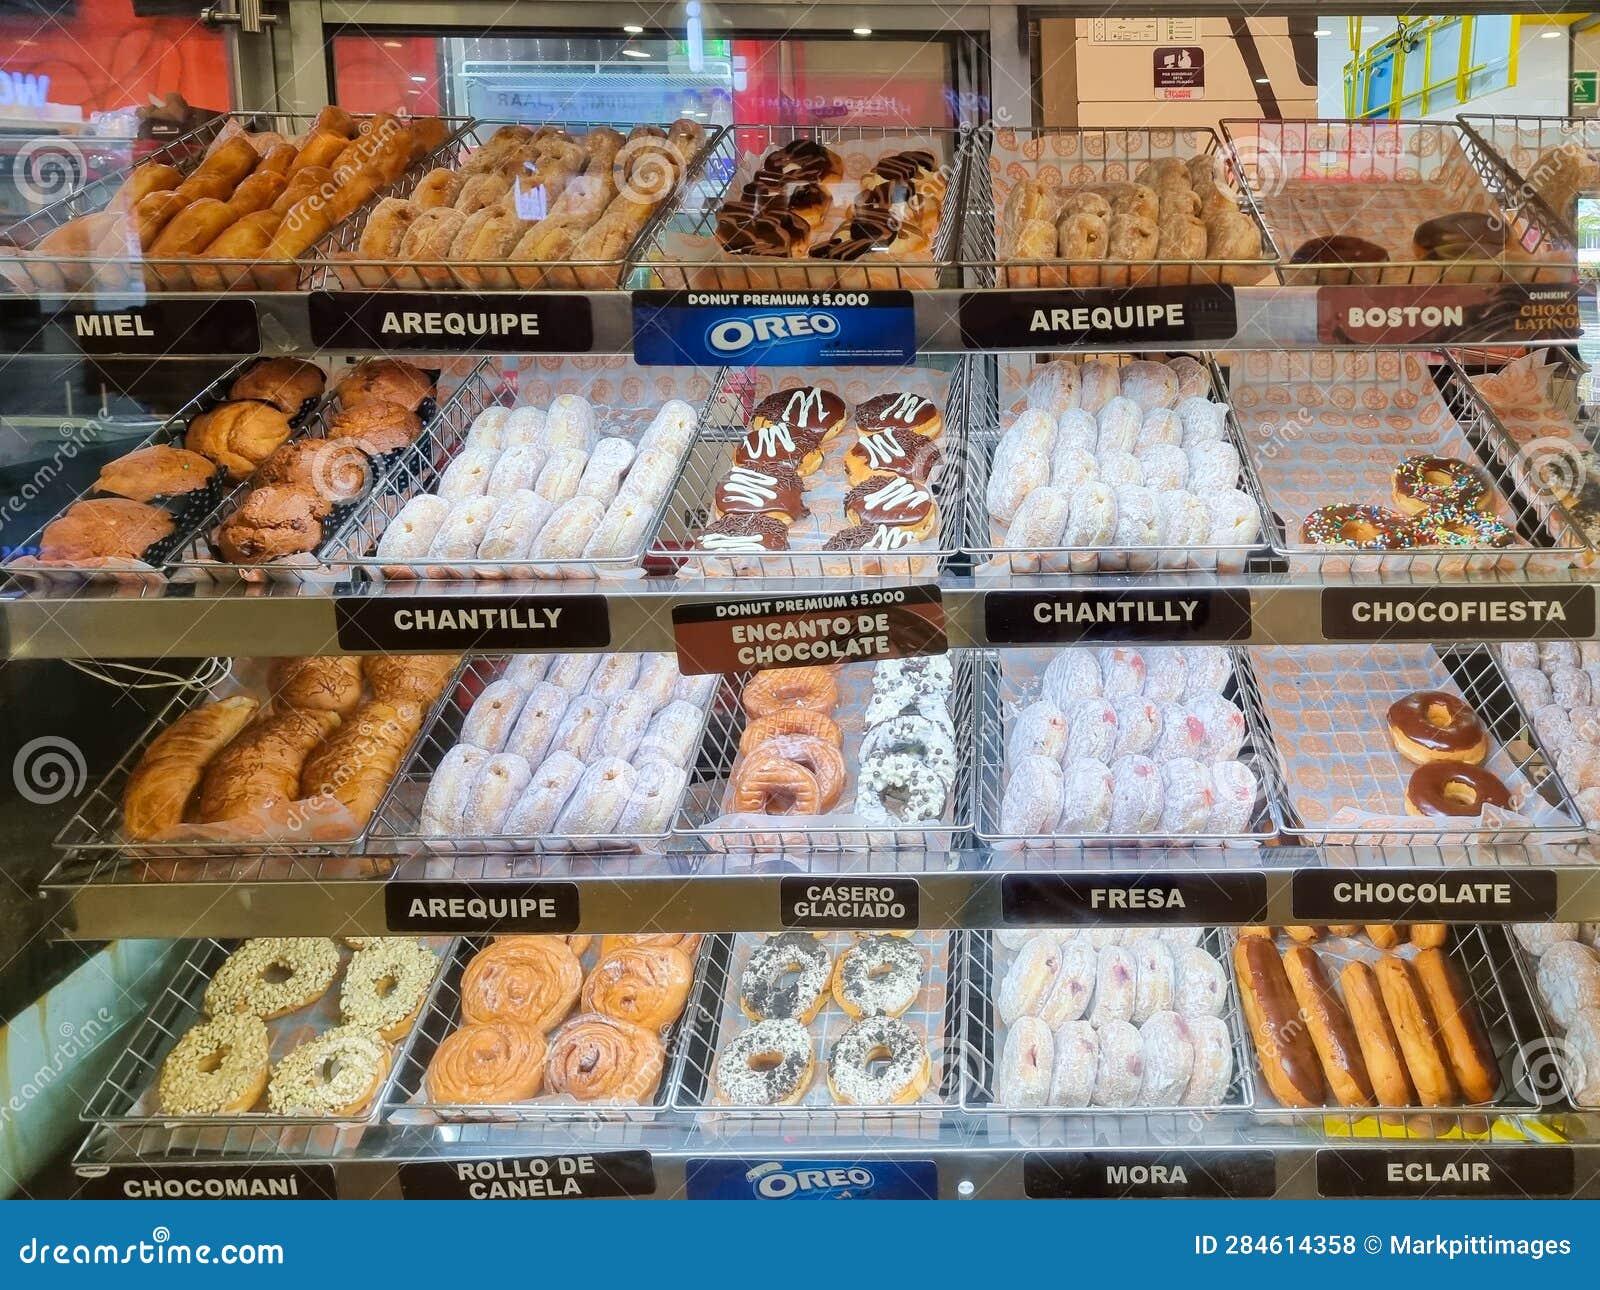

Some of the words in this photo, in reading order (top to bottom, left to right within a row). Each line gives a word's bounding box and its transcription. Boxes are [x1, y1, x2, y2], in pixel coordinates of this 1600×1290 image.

[688, 293, 738, 305] DONUT
[743, 294, 809, 306] PREMIUM
[1520, 304, 1577, 317] CHOCO
[75, 314, 154, 336] MIEL
[381, 312, 540, 336] AREQUIPE
[1029, 303, 1185, 332] AREQUIPE
[1348, 305, 1463, 328] BOSTON
[710, 314, 836, 350] OREO
[715, 602, 770, 617] DONUT
[775, 597, 847, 613] PREMIUM
[1033, 600, 1198, 623] CHANTILLY
[1352, 600, 1566, 622] CHOCOFIESTA
[394, 608, 562, 630] CHANTILLY
[731, 616, 850, 644] ENCANTO
[857, 613, 890, 633] DE
[737, 635, 890, 665] CHOCOLATE
[806, 886, 895, 902] CASERO
[1091, 888, 1186, 909] FRESA
[1333, 882, 1511, 904] CHOCOLATE
[408, 898, 556, 919] AREQUIPE
[794, 902, 905, 919] GLACIADO
[457, 1158, 549, 1181] ROLLO
[558, 1156, 596, 1176] DE
[1106, 1164, 1188, 1184] MORA
[1387, 1162, 1491, 1182] ECLAIR
[123, 1174, 298, 1198] CHOCOMANÍ
[469, 1177, 582, 1200] CANELA
[758, 1168, 871, 1198] OREO
